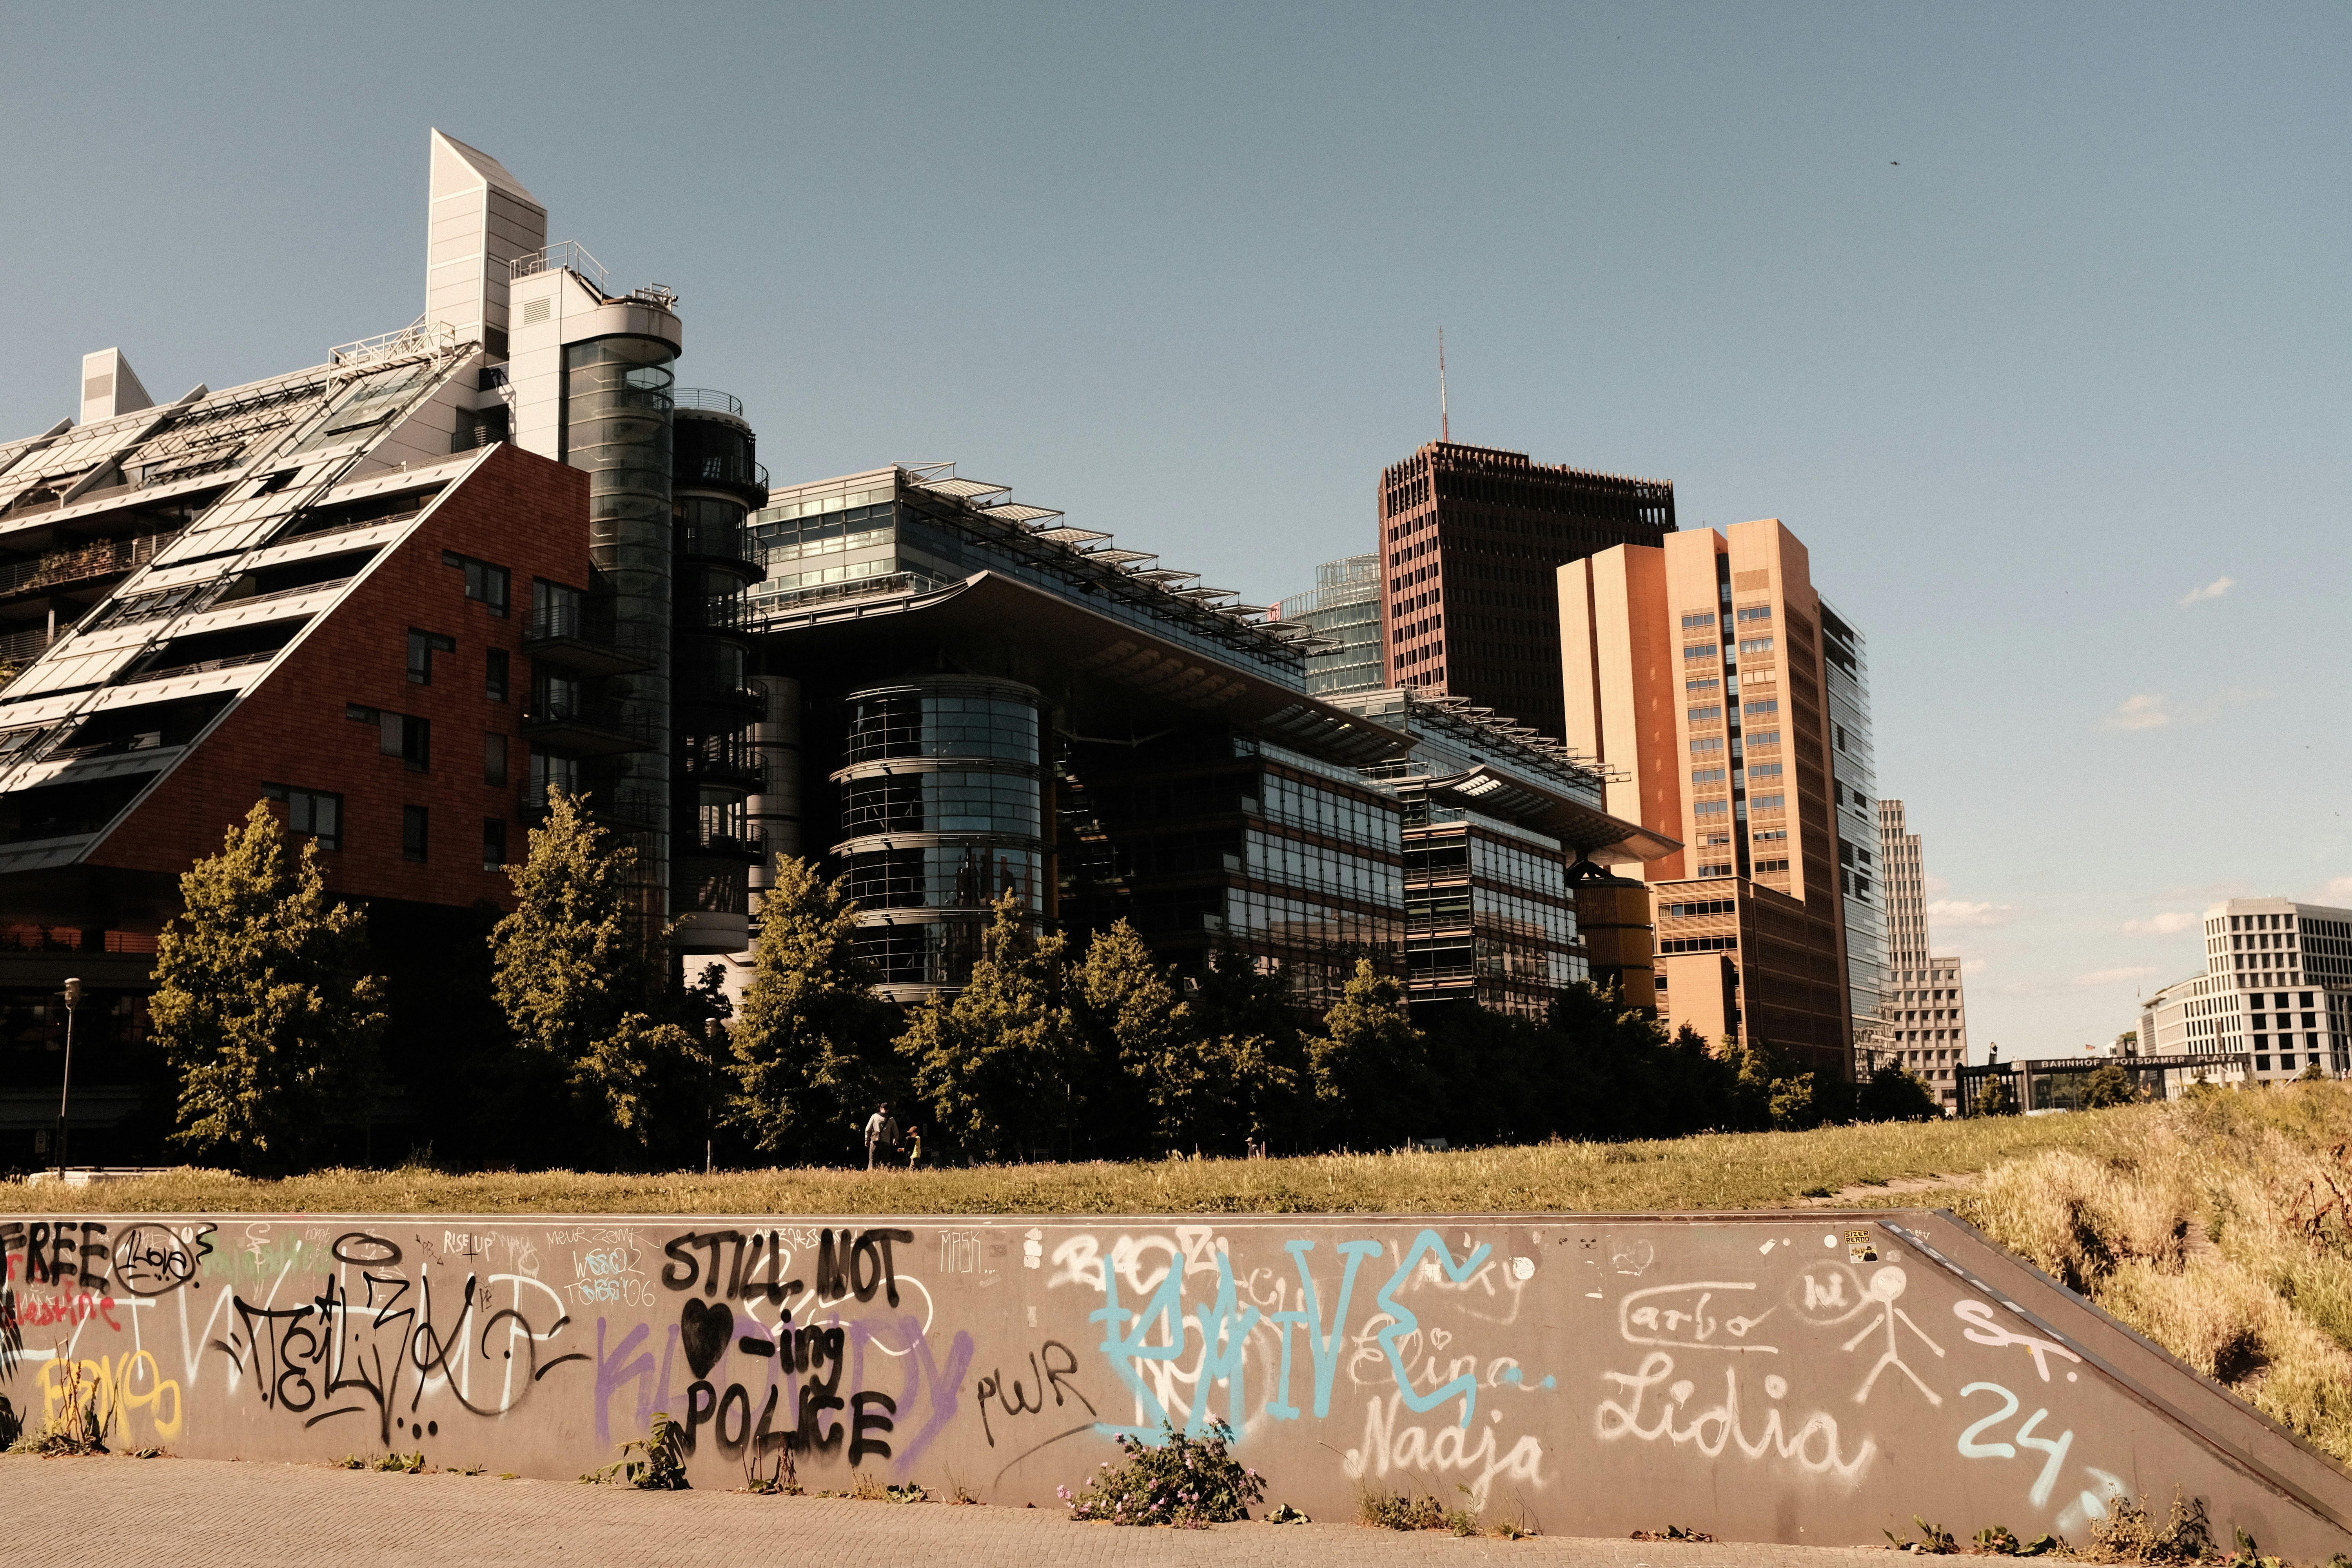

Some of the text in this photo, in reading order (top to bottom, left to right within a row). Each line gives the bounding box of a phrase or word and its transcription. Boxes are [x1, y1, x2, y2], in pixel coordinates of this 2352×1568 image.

[2042, 1054, 2235, 1068] BAHNHOF POTSDAMER PLATZ
[0, 1222, 111, 1295] FREE
[444, 1230, 469, 1253] RISE
[474, 1235, 493, 1261] UP
[662, 1229, 804, 1305] STILL
[817, 1228, 915, 1308] NOT
[682, 1380, 897, 1467] POLICE
[977, 1339, 1097, 1448] PWR
[1595, 1352, 1878, 1480] Lidia
[1345, 1392, 1552, 1512] Nadja
[1958, 1381, 2074, 1510] 24
